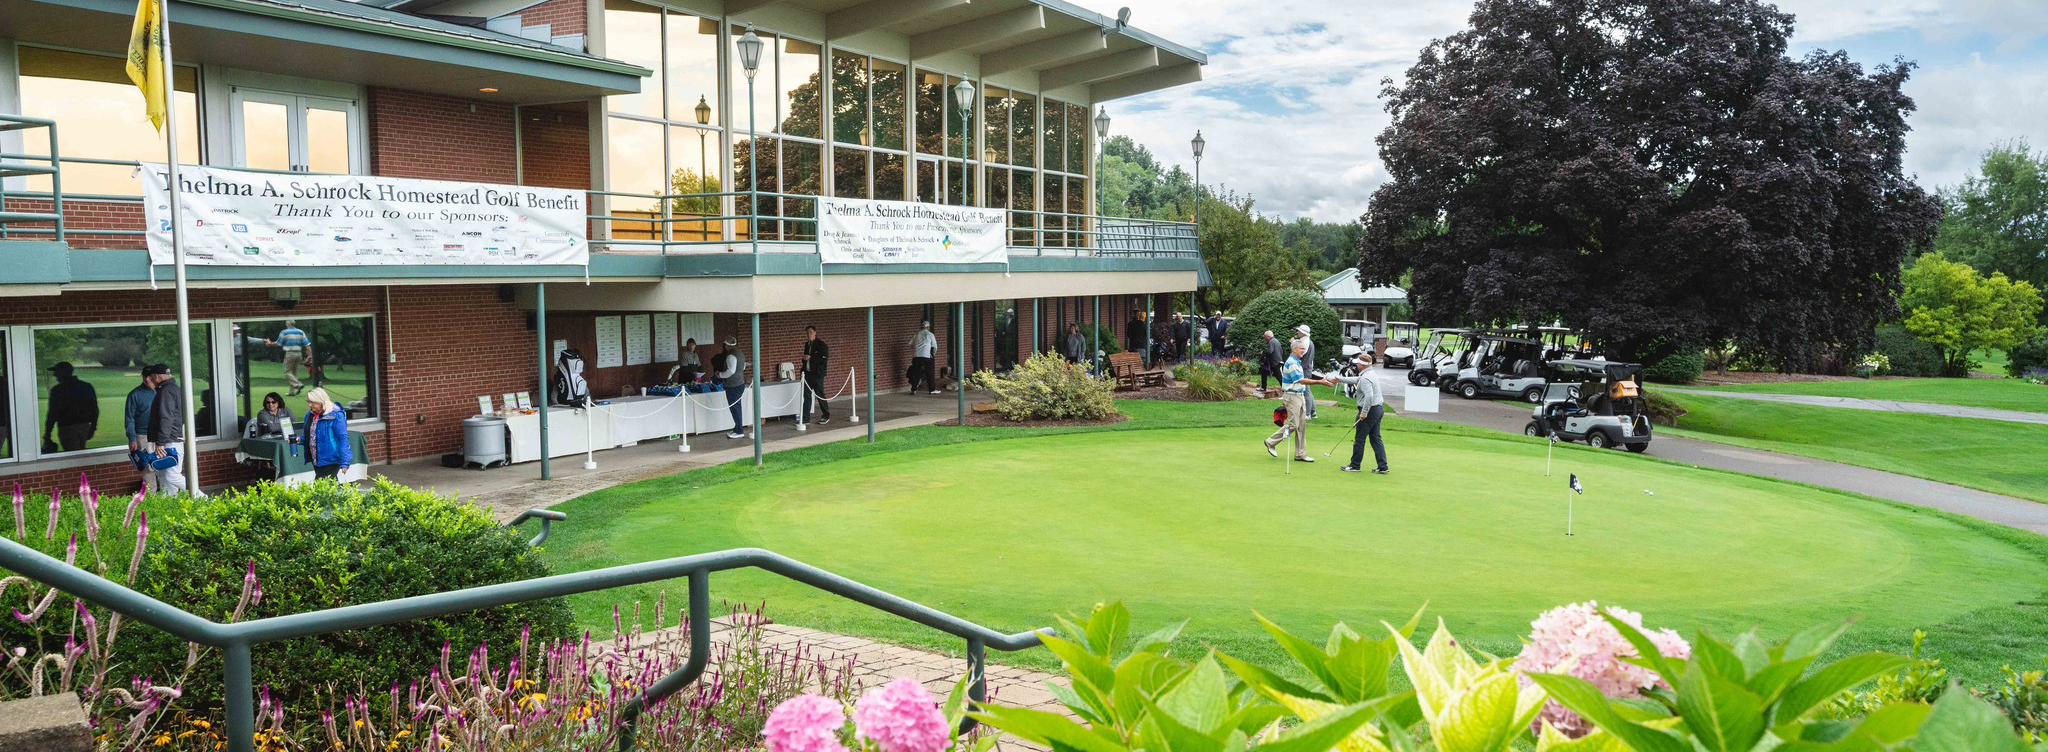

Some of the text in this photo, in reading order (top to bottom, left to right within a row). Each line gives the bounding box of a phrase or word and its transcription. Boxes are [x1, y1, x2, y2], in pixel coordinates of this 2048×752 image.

[157, 172, 580, 210] Thelma A. Schrock Homestead Golf Benefit
[274, 203, 333, 218] Thank
[342, 205, 374, 218] You
[382, 209, 401, 219] to
[407, 211, 434, 220] our
[440, 209, 508, 224] Sponsors:
[864, 204, 874, 217] A.
[876, 204, 911, 218] Schrock
[913, 206, 960, 222] Homestead
